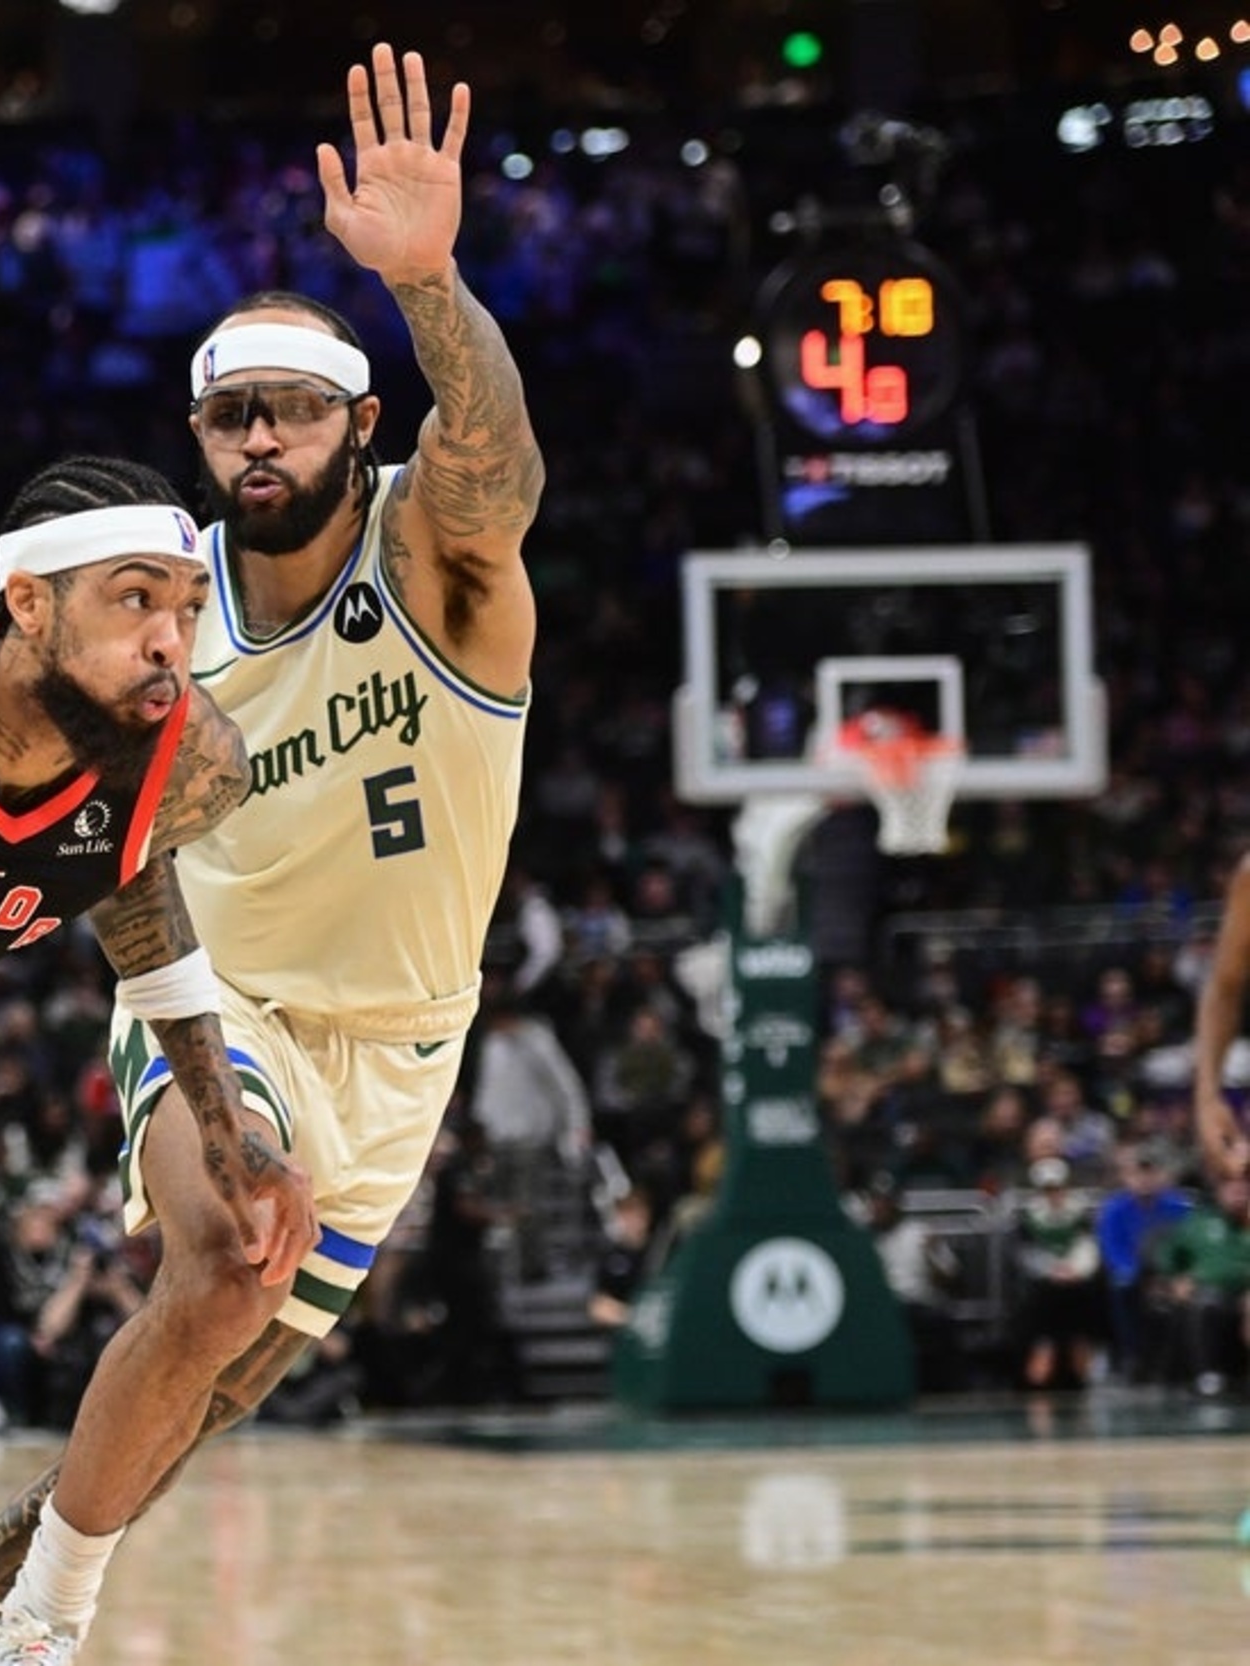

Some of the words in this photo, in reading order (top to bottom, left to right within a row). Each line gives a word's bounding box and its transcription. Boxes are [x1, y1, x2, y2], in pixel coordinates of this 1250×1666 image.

[238, 728, 326, 807] am
[327, 669, 429, 756] City
[56, 842, 84, 858] Sun
[85, 838, 114, 854] Life
[362, 764, 426, 860] 5
